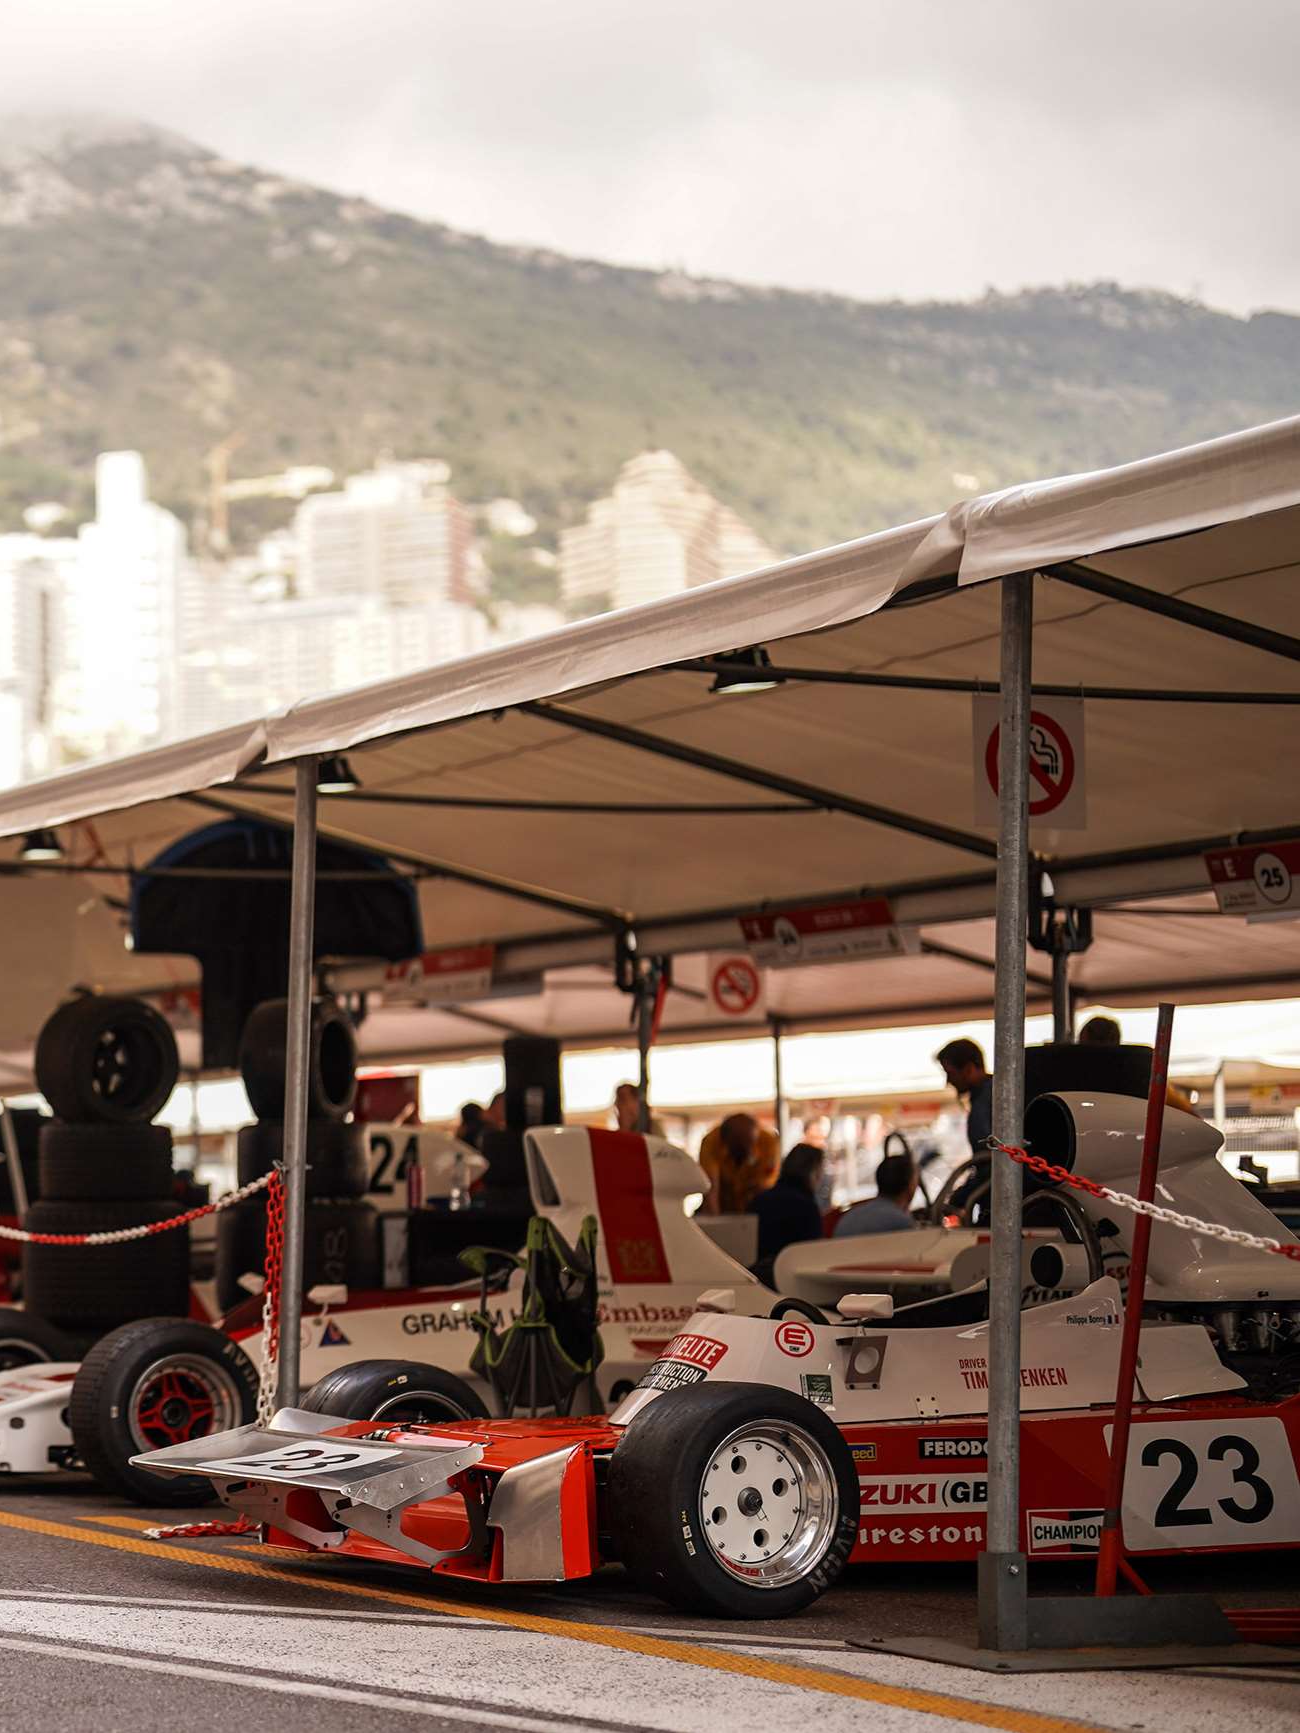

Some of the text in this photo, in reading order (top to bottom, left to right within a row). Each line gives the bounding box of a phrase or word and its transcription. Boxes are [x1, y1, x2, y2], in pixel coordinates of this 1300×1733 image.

[1261, 867, 1284, 888] 25
[1021, 1285, 1074, 1306] YEAR
[598, 1302, 700, 1322] Embas
[959, 1358, 987, 1370] DRIVER
[961, 1367, 1069, 1390] TIM ENKEN
[227, 1449, 360, 1471] 23
[851, 1447, 875, 1459] eed
[1141, 1435, 1275, 1528] 23
[859, 1480, 988, 1508] ZUKI (GB
[859, 1525, 984, 1545] ireston
